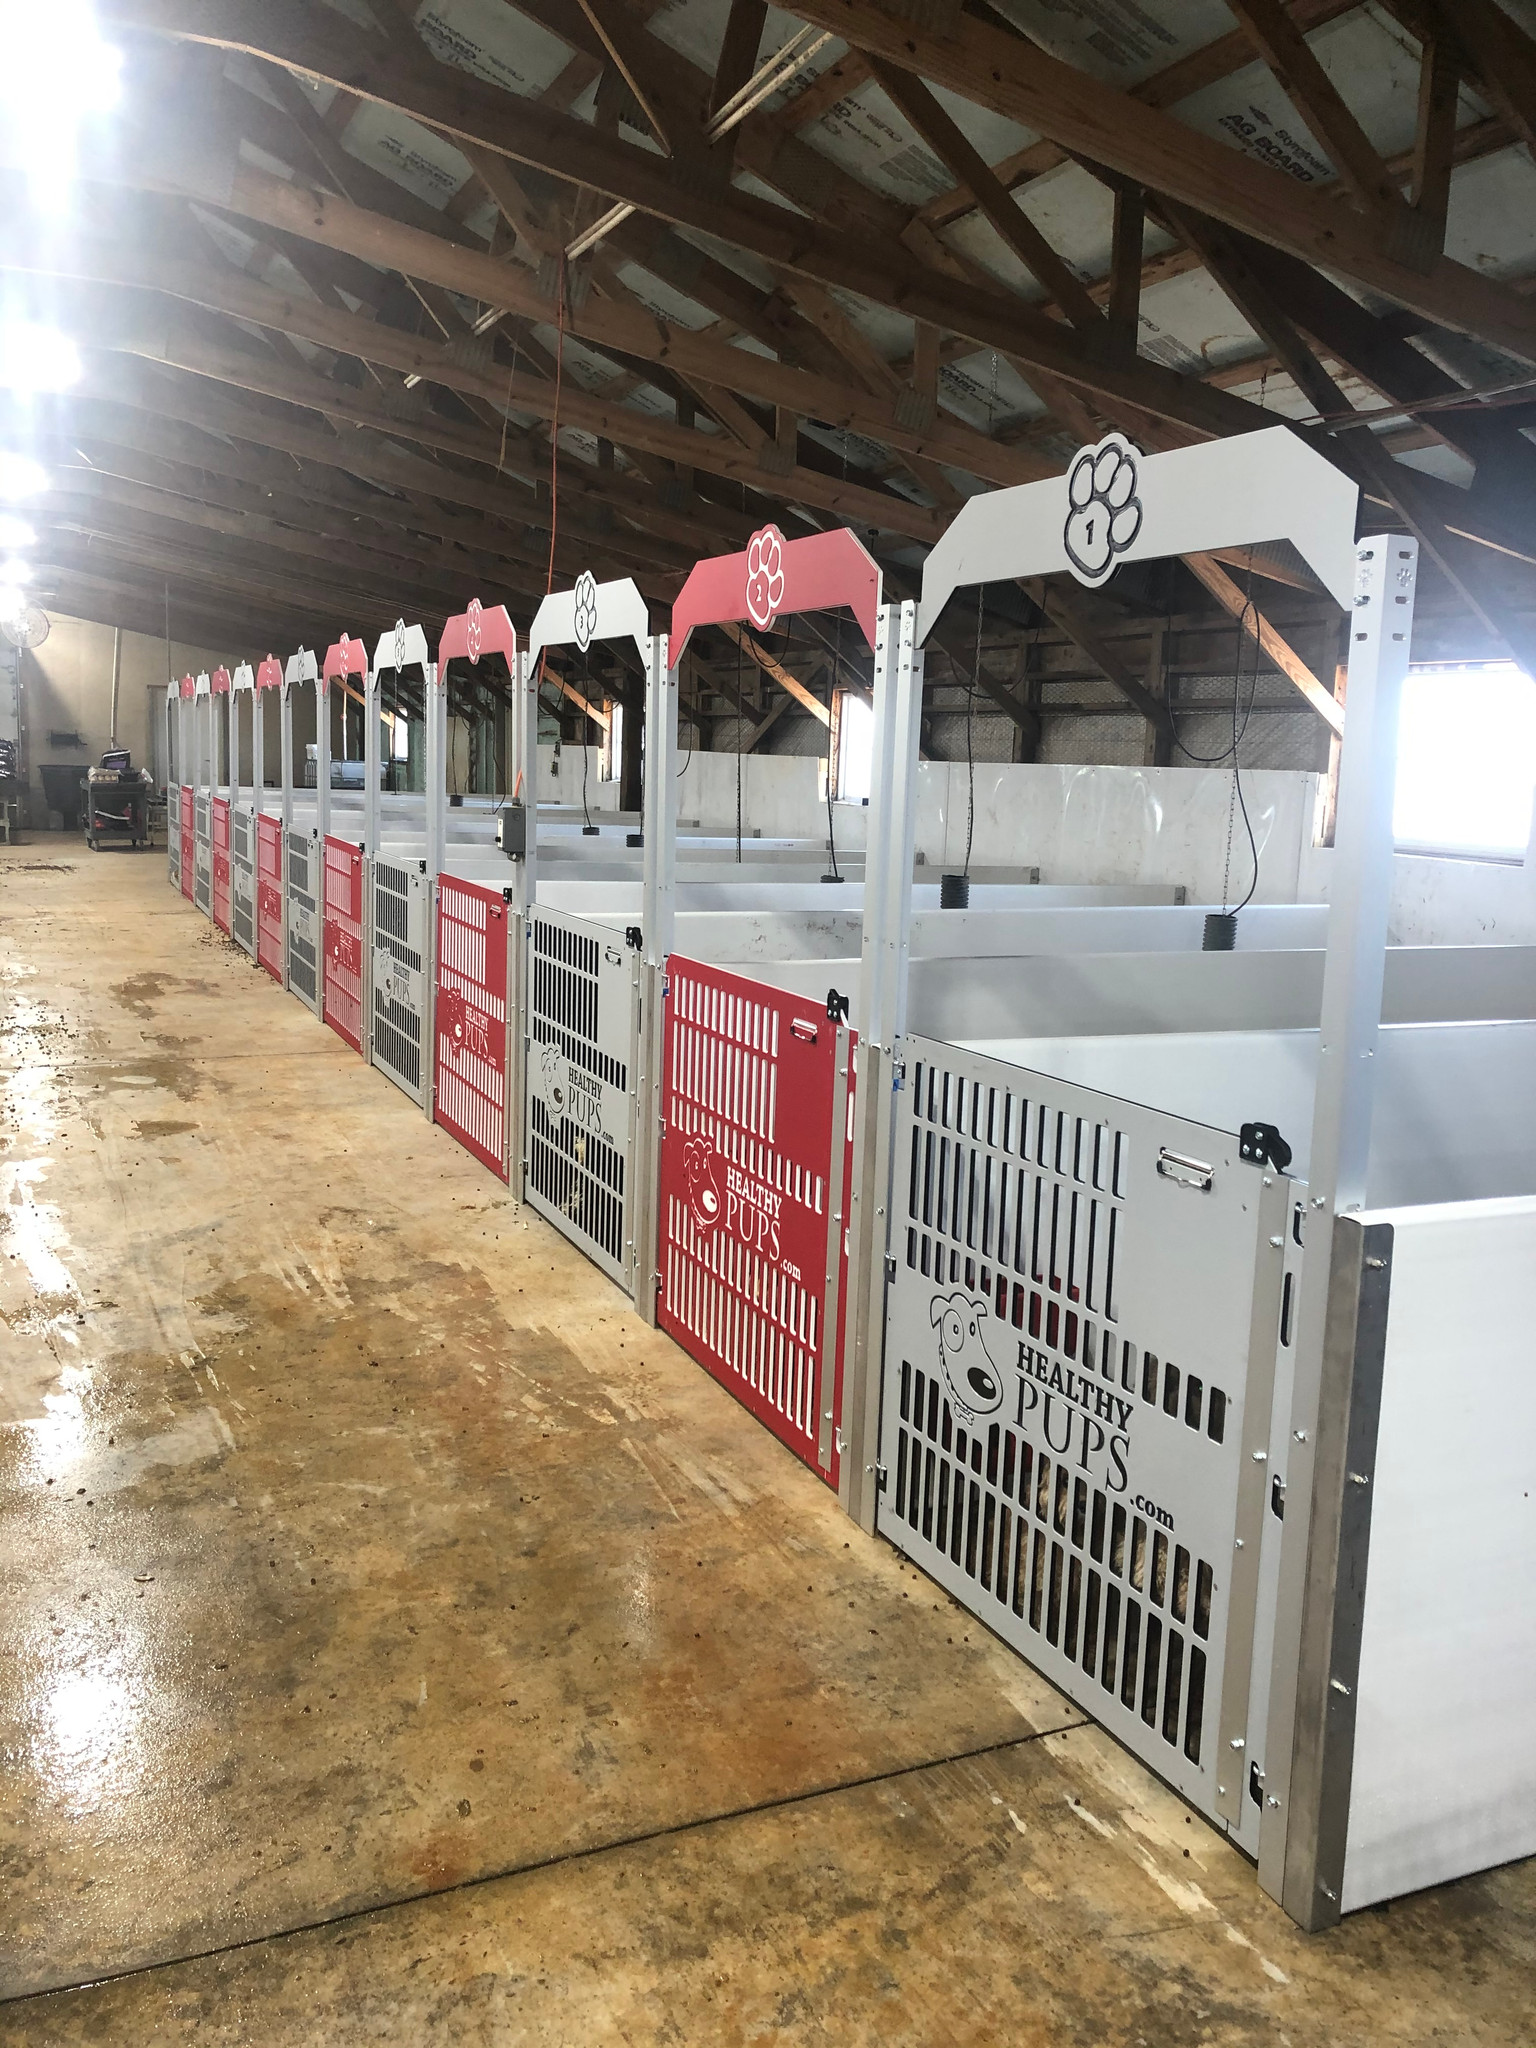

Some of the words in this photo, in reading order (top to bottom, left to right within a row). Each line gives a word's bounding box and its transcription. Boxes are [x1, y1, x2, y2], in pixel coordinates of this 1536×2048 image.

[1086, 519, 1094, 545] 1
[756, 584, 762, 602] 2
[465, 1020, 488, 1058] PUPS
[568, 1066, 602, 1100] HEALTHY
[568, 1085, 602, 1134] PUPS
[726, 1166, 782, 1219] HEALTHY
[725, 1189, 780, 1261] PUPS
[780, 1258, 801, 1281] .com
[1016, 1340, 1133, 1433] HEALTHY
[1012, 1373, 1131, 1493] PUPS
[1129, 1494, 1175, 1532] .com
